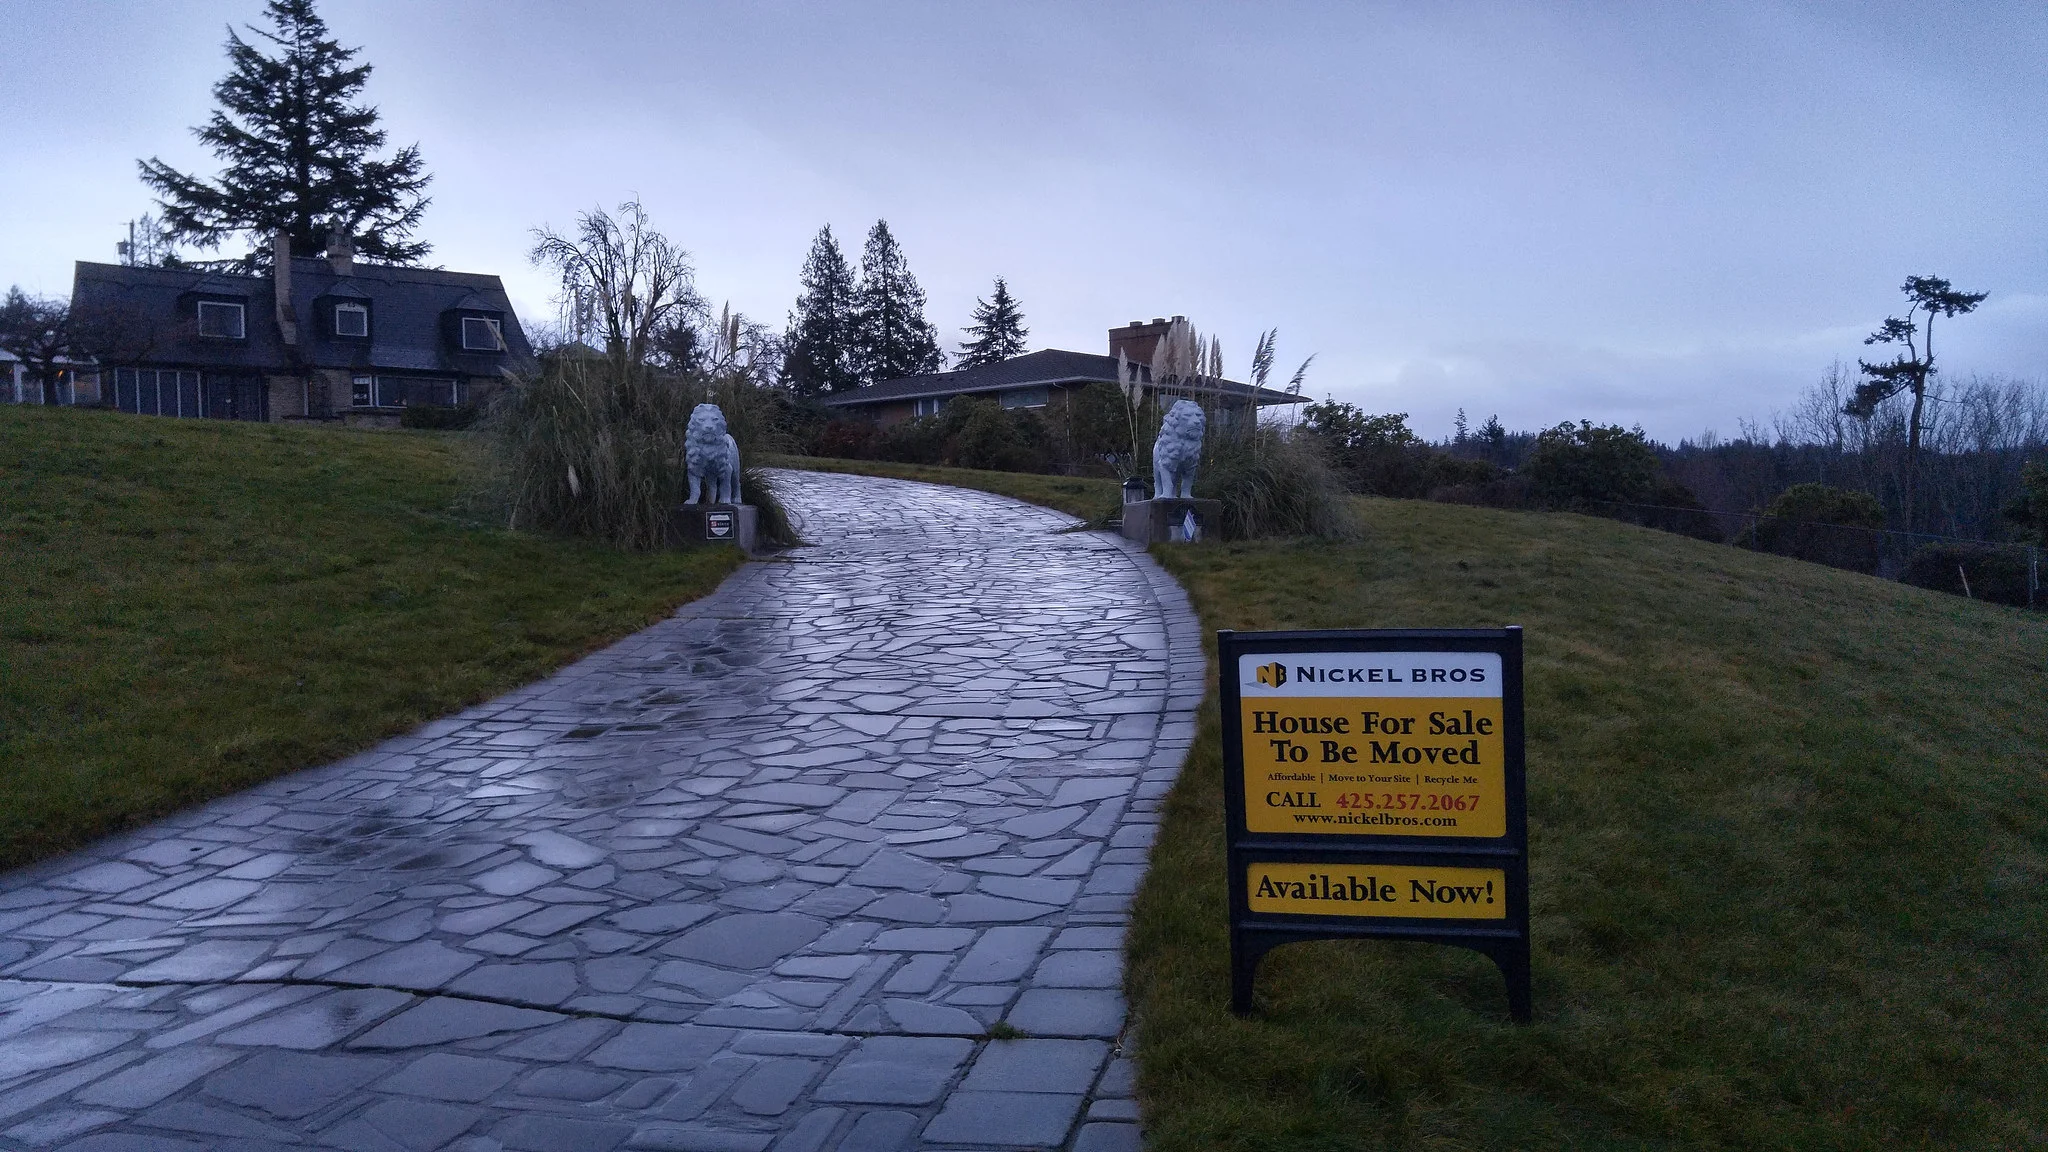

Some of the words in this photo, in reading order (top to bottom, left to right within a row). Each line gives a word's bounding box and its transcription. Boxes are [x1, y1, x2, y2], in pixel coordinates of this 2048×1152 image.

[1297, 667, 1402, 683] NICKEL
[1412, 668, 1485, 683] BROS
[1253, 712, 1349, 734] House
[1361, 712, 1415, 735] For
[1429, 711, 1493, 736] Sale
[1270, 740, 1308, 763] To
[1321, 741, 1357, 763] Be
[1369, 740, 1480, 765] Moved
[1268, 773, 1315, 781] Affordable
[1329, 774, 1354, 782] Move
[1368, 774, 1392, 783] Your
[1394, 774, 1411, 783] Site
[1424, 775, 1459, 785] Recycle
[1266, 792, 1321, 808] CALL
[1336, 793, 1480, 811] 425.257.2067
[1294, 813, 1457, 827] www.nickelbros.com
[1256, 874, 1397, 902] Available
[1410, 880, 1494, 904] Now!
